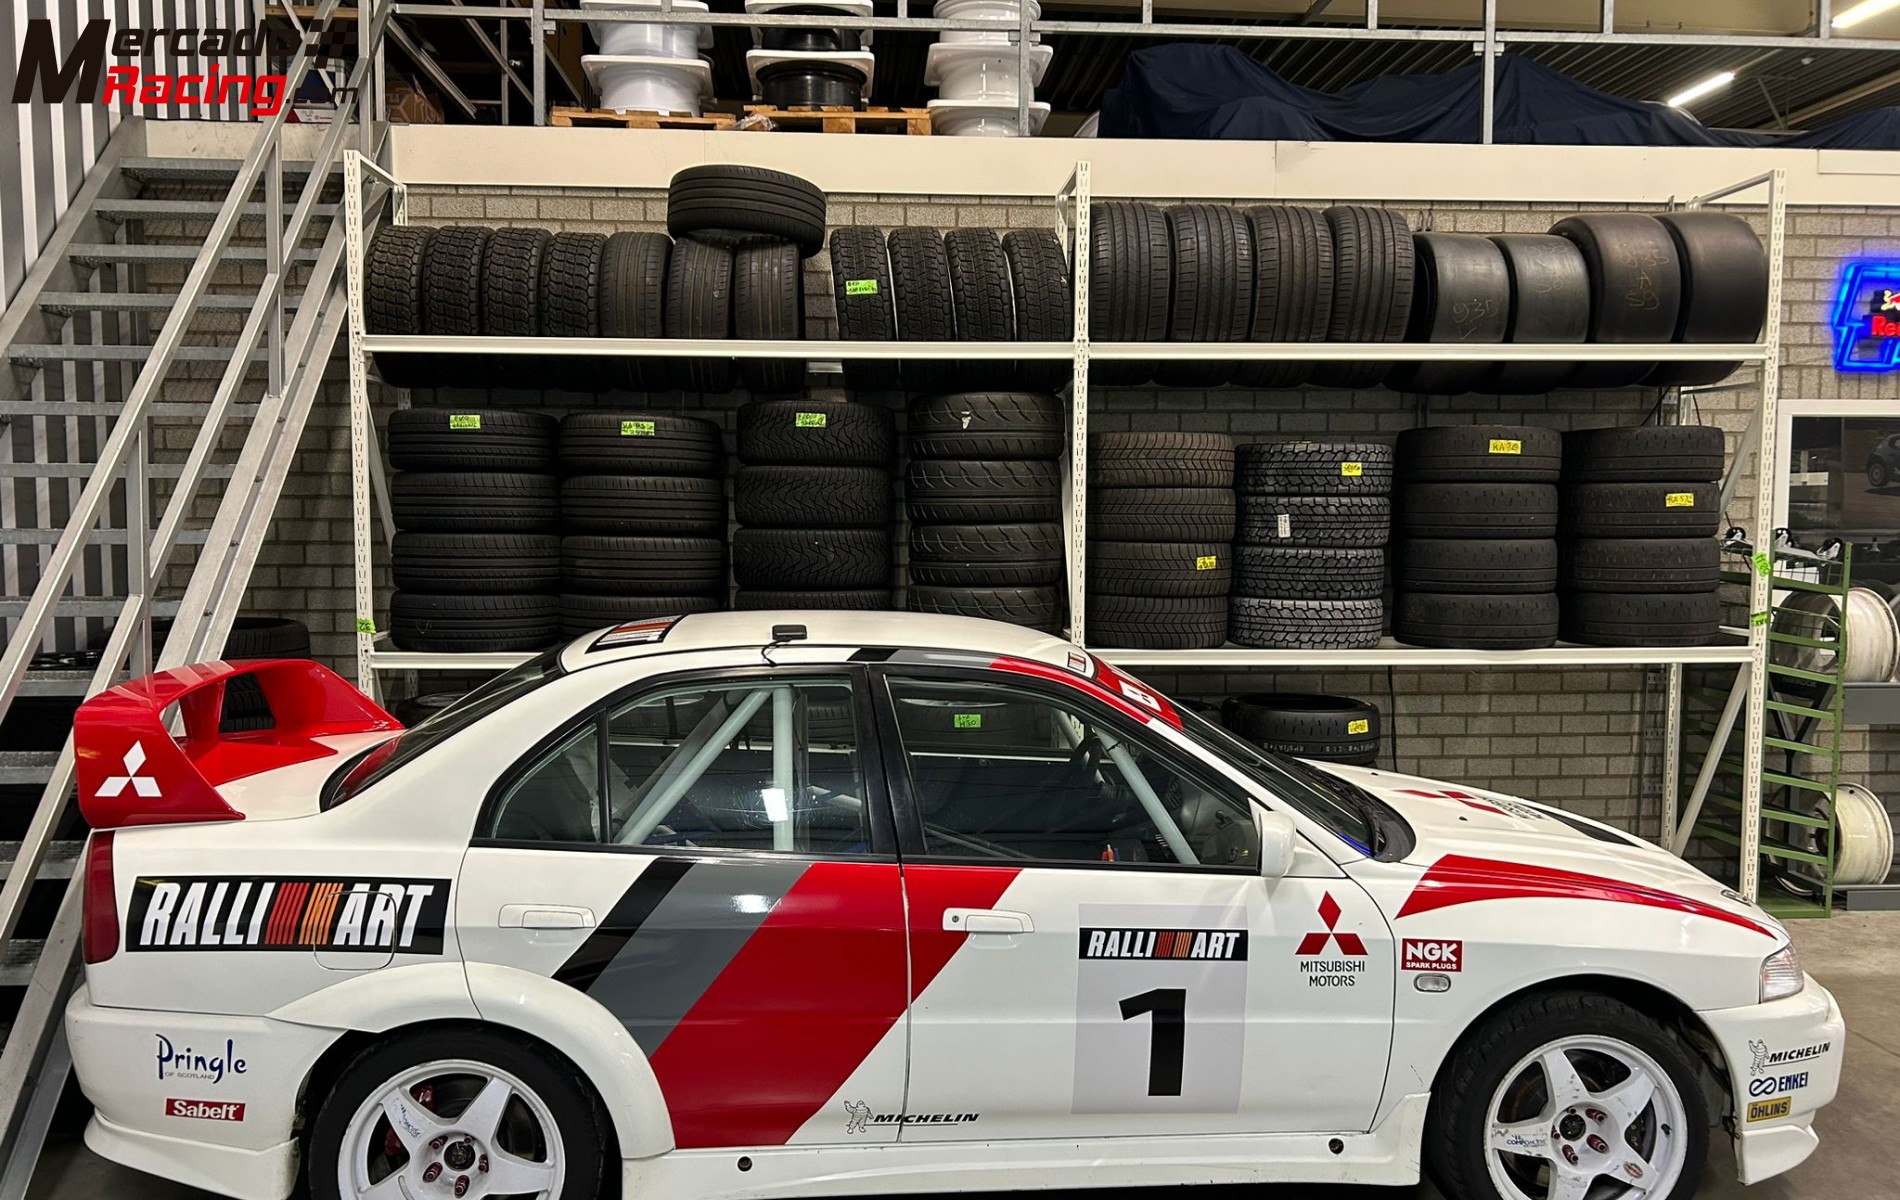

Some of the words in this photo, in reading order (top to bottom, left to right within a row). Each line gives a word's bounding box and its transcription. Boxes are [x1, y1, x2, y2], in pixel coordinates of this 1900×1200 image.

[139, 882, 276, 946] RALLI
[333, 882, 435, 948] ART
[1086, 930, 1157, 958] RALLI
[1190, 931, 1240, 959] ART
[1406, 942, 1458, 962] NGK
[1300, 960, 1365, 972] MITSUBISHI
[1406, 961, 1431, 969] SPARK
[1432, 962, 1457, 970] PLUGS
[1309, 975, 1355, 987] MOTORS
[1118, 988, 1187, 1097] 1
[1769, 1041, 1831, 1063] MICHELIN
[155, 1033, 247, 1084] Pringle
[1778, 1071, 1809, 1092] ENKEI
[172, 1100, 237, 1120] Sabelt
[873, 1113, 980, 1123] MICHELIN
[1750, 1102, 1788, 1119] ÖHLINS
